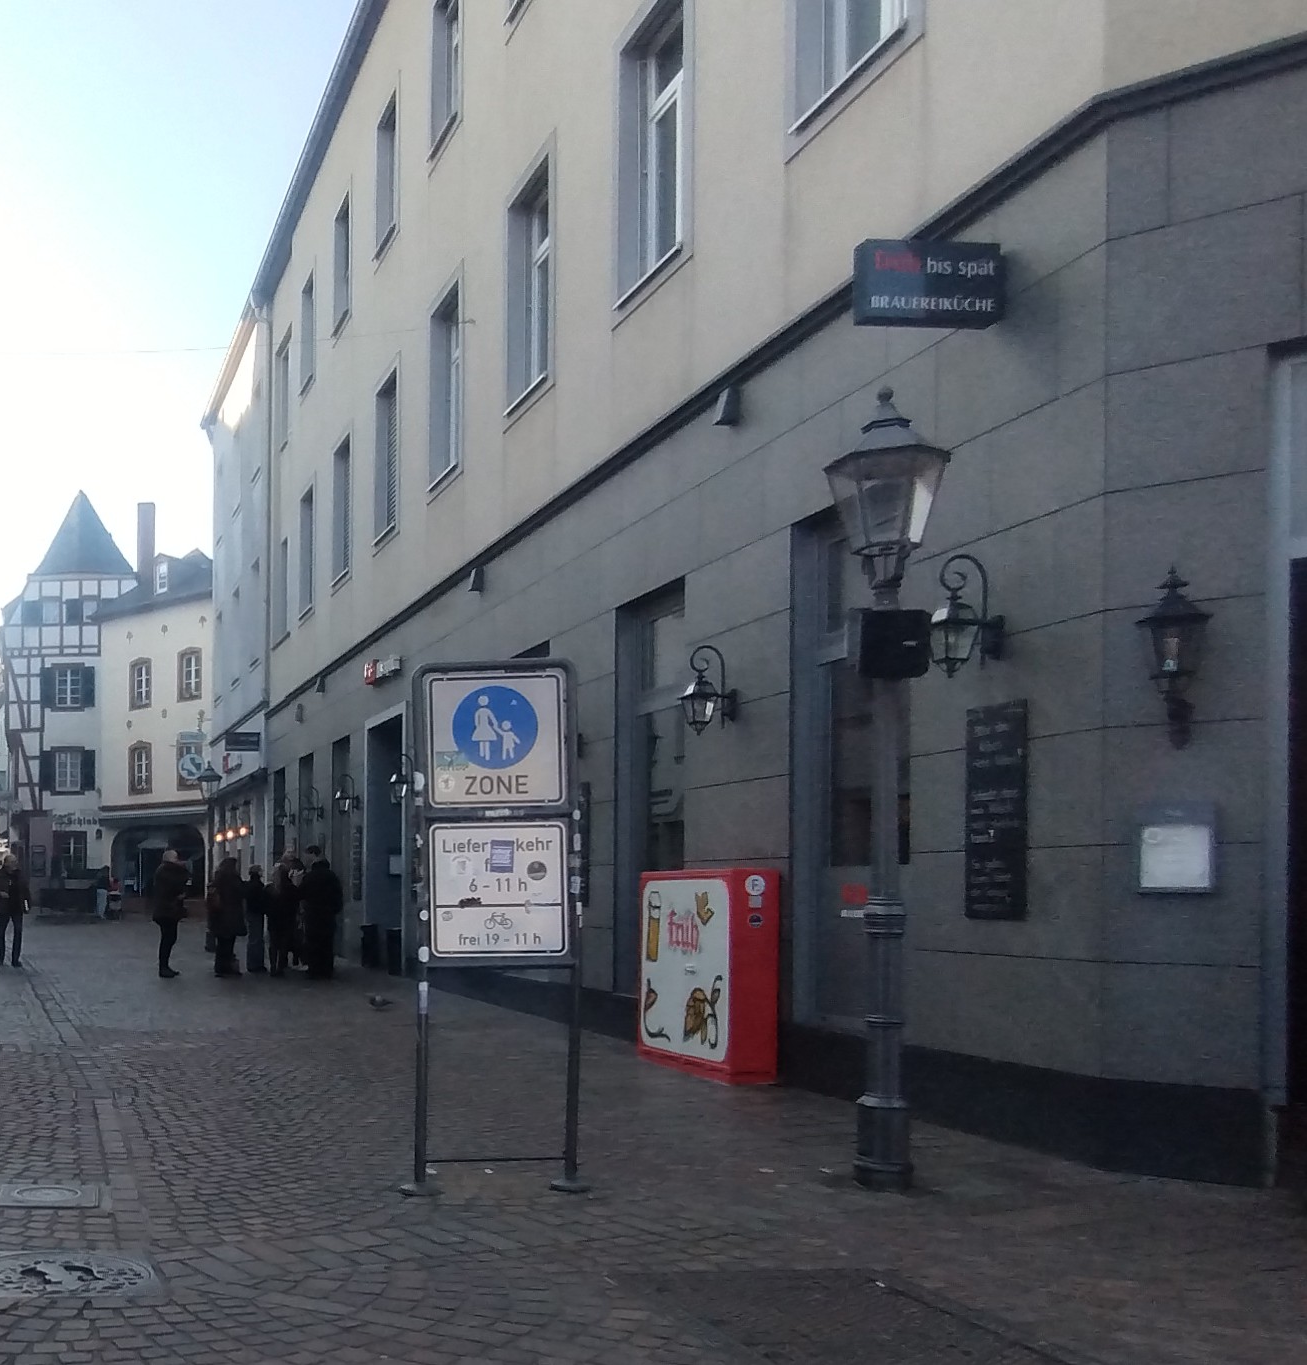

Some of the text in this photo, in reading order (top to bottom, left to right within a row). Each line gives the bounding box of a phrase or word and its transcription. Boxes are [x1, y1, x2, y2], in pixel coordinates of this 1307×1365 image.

[926, 256, 952, 275] bis
[871, 295, 995, 312] BRAUEREIKÜCHE
[465, 775, 529, 795] ZONE
[443, 837, 553, 853] Lieferkehr
[469, 878, 478, 893] 6
[496, 878, 511, 893] 11
[518, 877, 528, 892] h
[459, 933, 481, 946] frei
[486, 933, 500, 945] 19
[514, 932, 527, 945] 11
[533, 932, 542, 945] h
